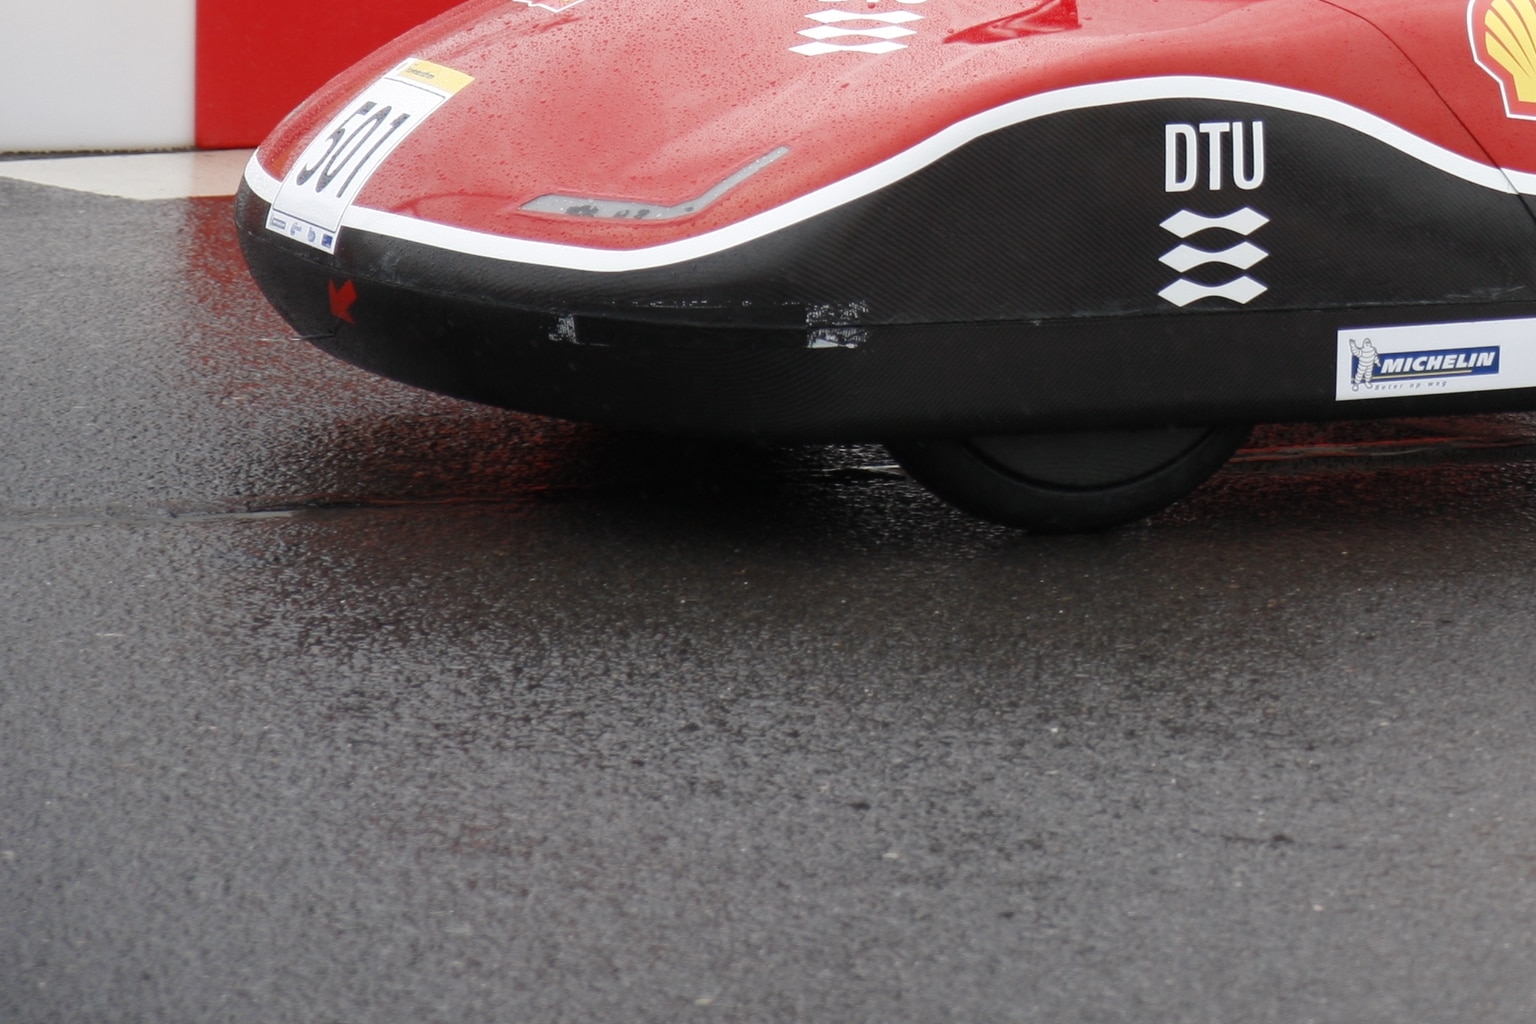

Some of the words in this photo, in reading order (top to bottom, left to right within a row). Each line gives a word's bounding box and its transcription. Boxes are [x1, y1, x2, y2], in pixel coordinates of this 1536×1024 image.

[295, 100, 412, 199] 501
[1164, 120, 1265, 193] DTU
[1379, 351, 1496, 375] MICHELIN
